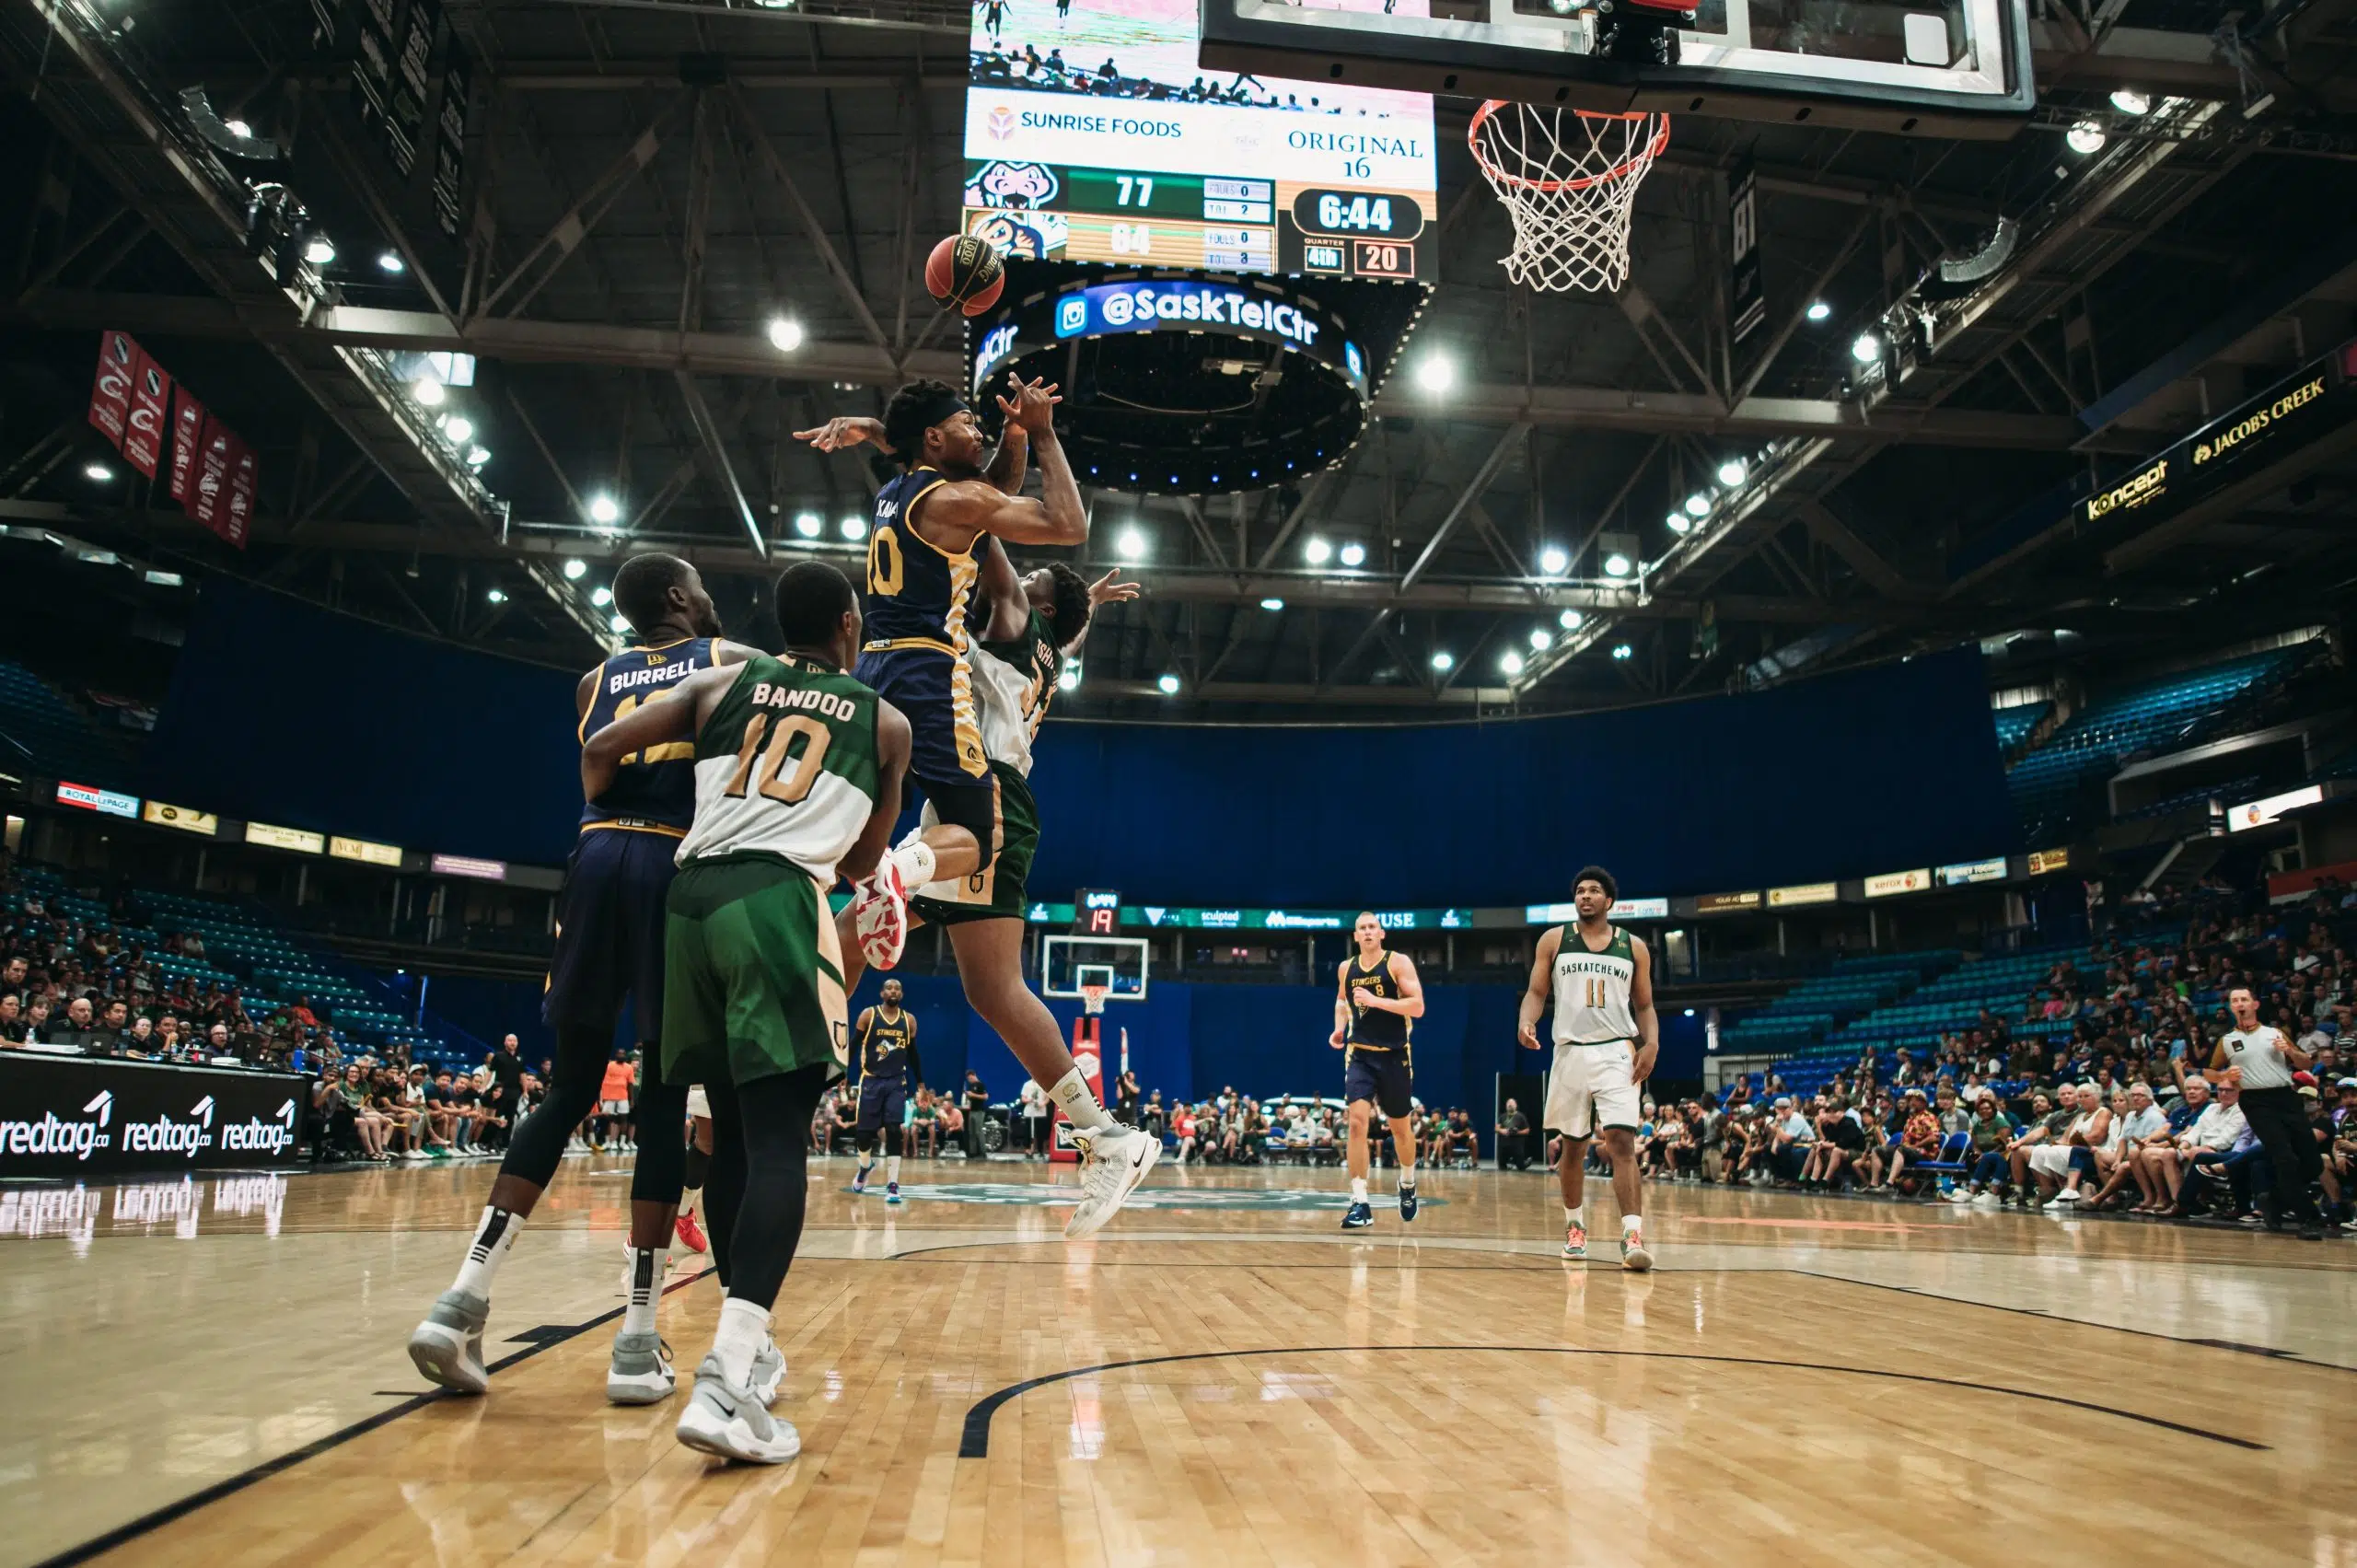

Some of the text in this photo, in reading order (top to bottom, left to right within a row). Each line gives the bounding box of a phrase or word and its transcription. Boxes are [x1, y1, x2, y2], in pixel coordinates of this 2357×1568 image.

[1021, 111, 1183, 138] SUNRISE FOODS
[1288, 130, 1424, 158] ORIGINAL
[1344, 157, 1371, 179] 16
[1116, 176, 1154, 207] 77
[1240, 186, 1248, 197] 0
[1241, 204, 1248, 215] 2
[1318, 193, 1392, 232] 6:44
[1240, 232, 1248, 243] 0
[1304, 238, 1345, 247] QUARTER
[1308, 248, 1338, 267] 4th
[1365, 245, 1398, 271] 20
[1102, 289, 1318, 345] @SaskTelCtr
[2212, 377, 2325, 457] JACOB'S CREEK
[610, 658, 698, 694] BURRELL
[752, 683, 856, 722] BANDOO
[724, 712, 832, 807] 10
[65, 789, 96, 803] ROYAL
[1091, 909, 1112, 933] 19
[1562, 962, 1629, 982] SASKATCHEWAN
[1375, 984, 1385, 997] 8
[1586, 977, 1606, 1008] 11
[896, 1038, 906, 1049] 23
[122, 1113, 212, 1158] redtag.ca
[221, 1115, 294, 1156] redtag.ca
